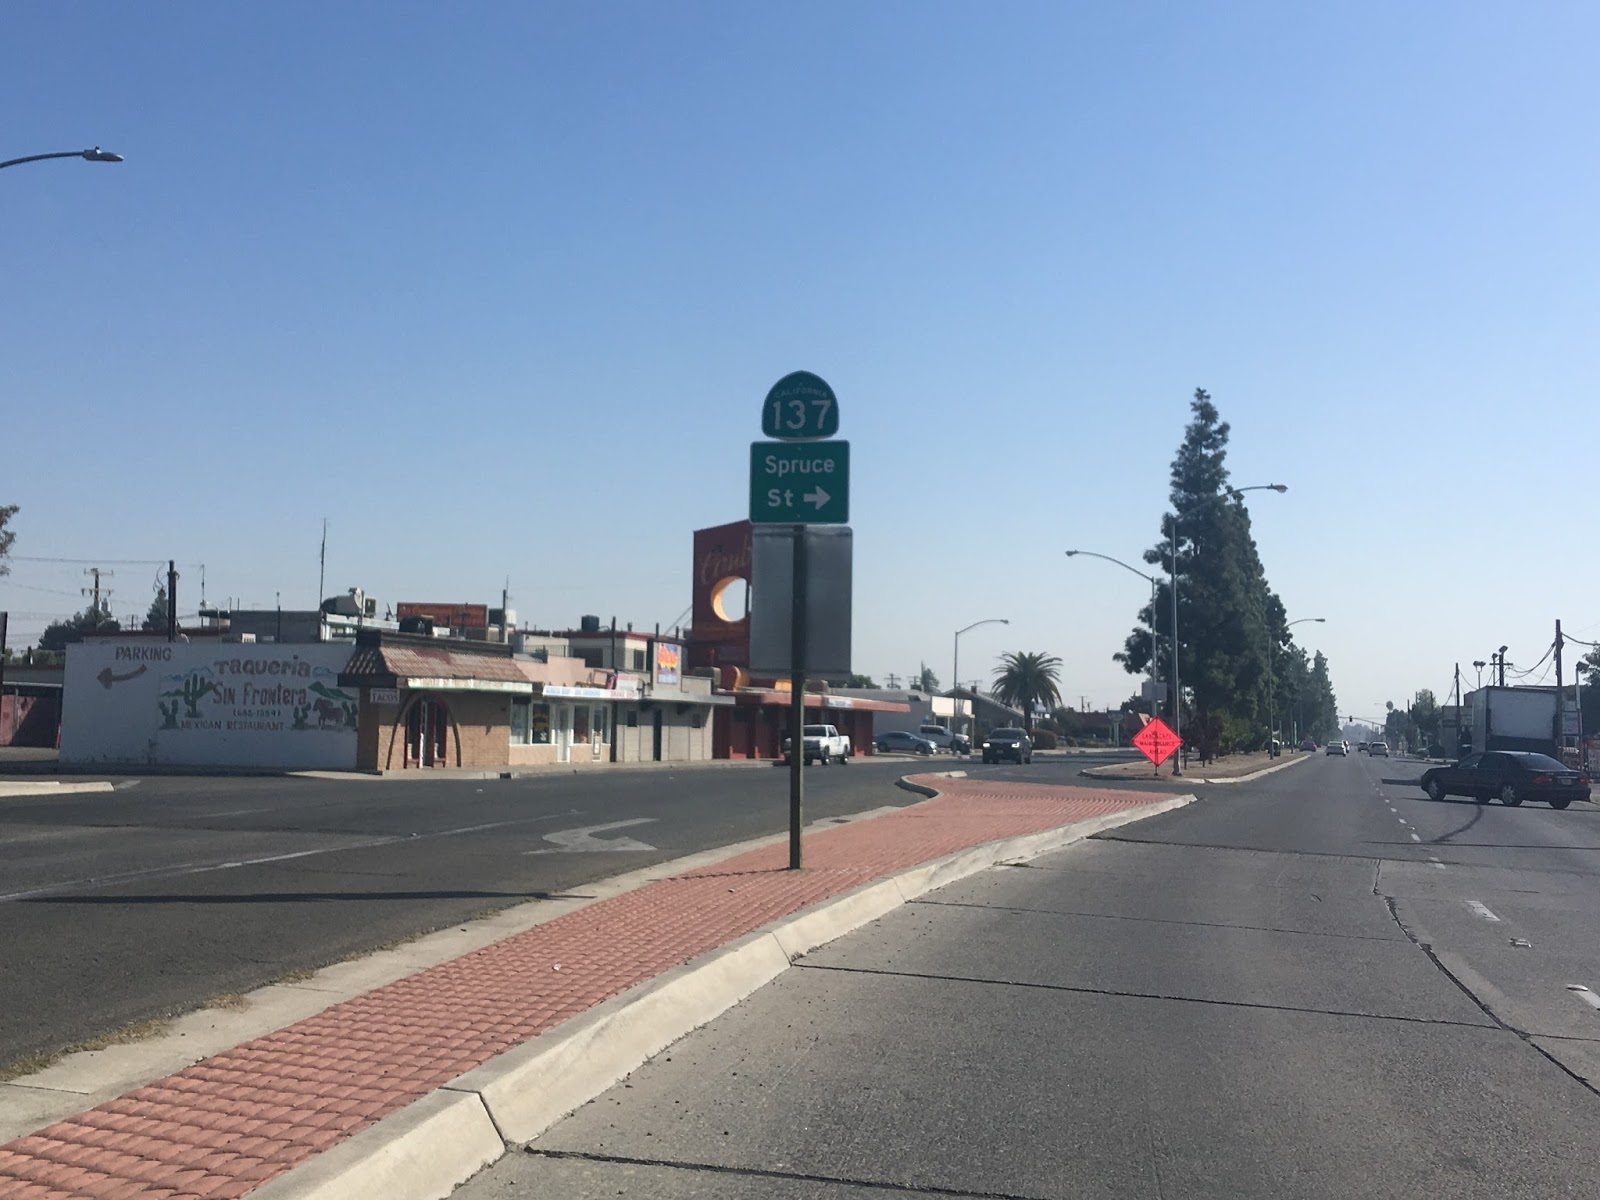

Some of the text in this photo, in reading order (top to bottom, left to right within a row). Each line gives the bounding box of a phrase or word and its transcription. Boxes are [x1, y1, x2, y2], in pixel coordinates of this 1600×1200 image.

[773, 400, 832, 430] 137
[765, 455, 835, 478] Spruce
[767, 488, 794, 508] St
[115, 646, 172, 661] PARKING
[181, 720, 285, 731] MEXICAN RESTAURANT
